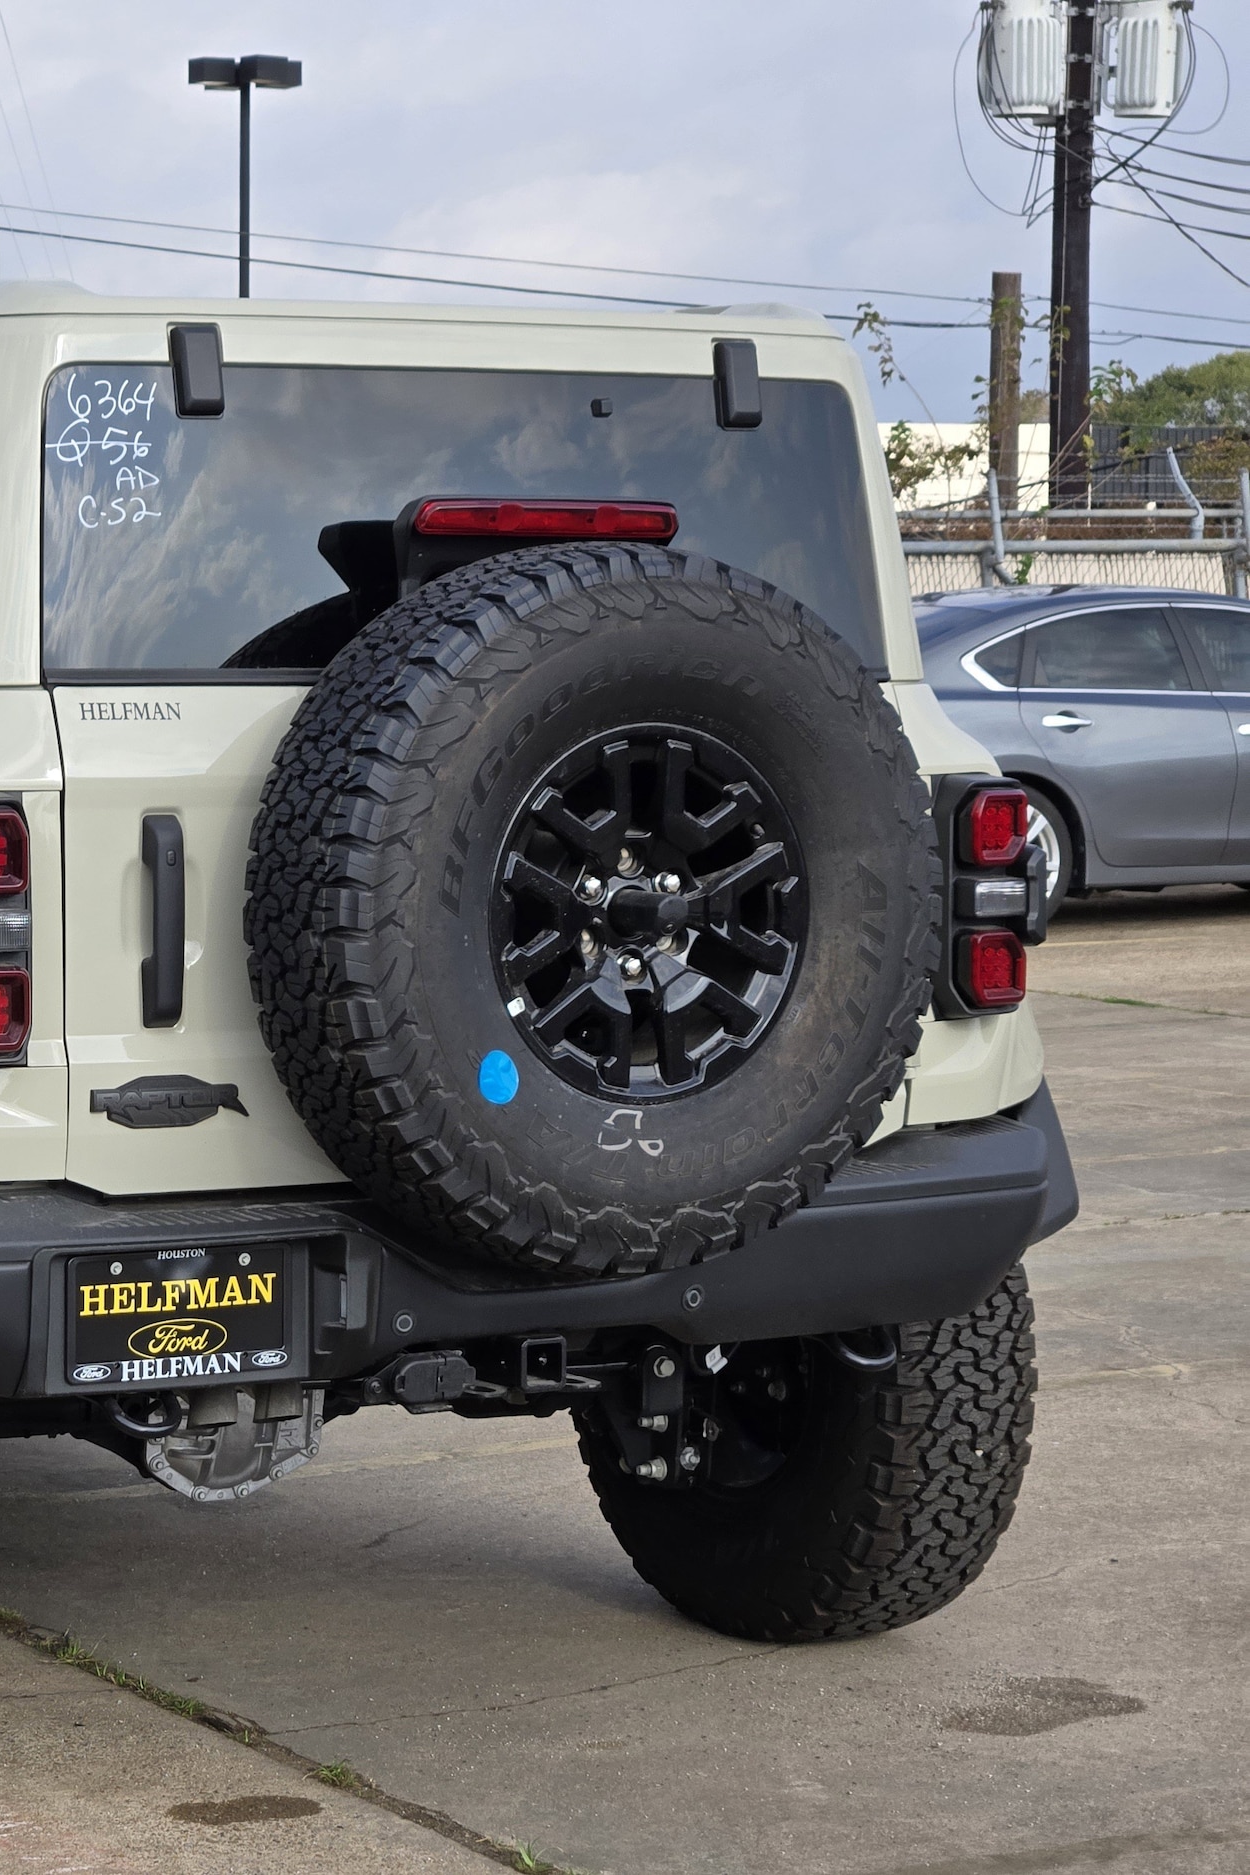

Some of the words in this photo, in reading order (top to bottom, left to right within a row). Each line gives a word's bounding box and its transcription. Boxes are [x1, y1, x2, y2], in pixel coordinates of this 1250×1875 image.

[66, 372, 158, 421] 6364
[79, 701, 182, 721] HELFMAN
[90, 1083, 250, 1123] RAPTOR
[157, 1247, 207, 1260] HOUSTON
[79, 1272, 277, 1316] HELFMAN
[147, 1323, 210, 1354] Ford
[78, 1365, 110, 1381] Ford
[120, 1352, 243, 1382] HELFMAN
[257, 1351, 284, 1365] Ford
